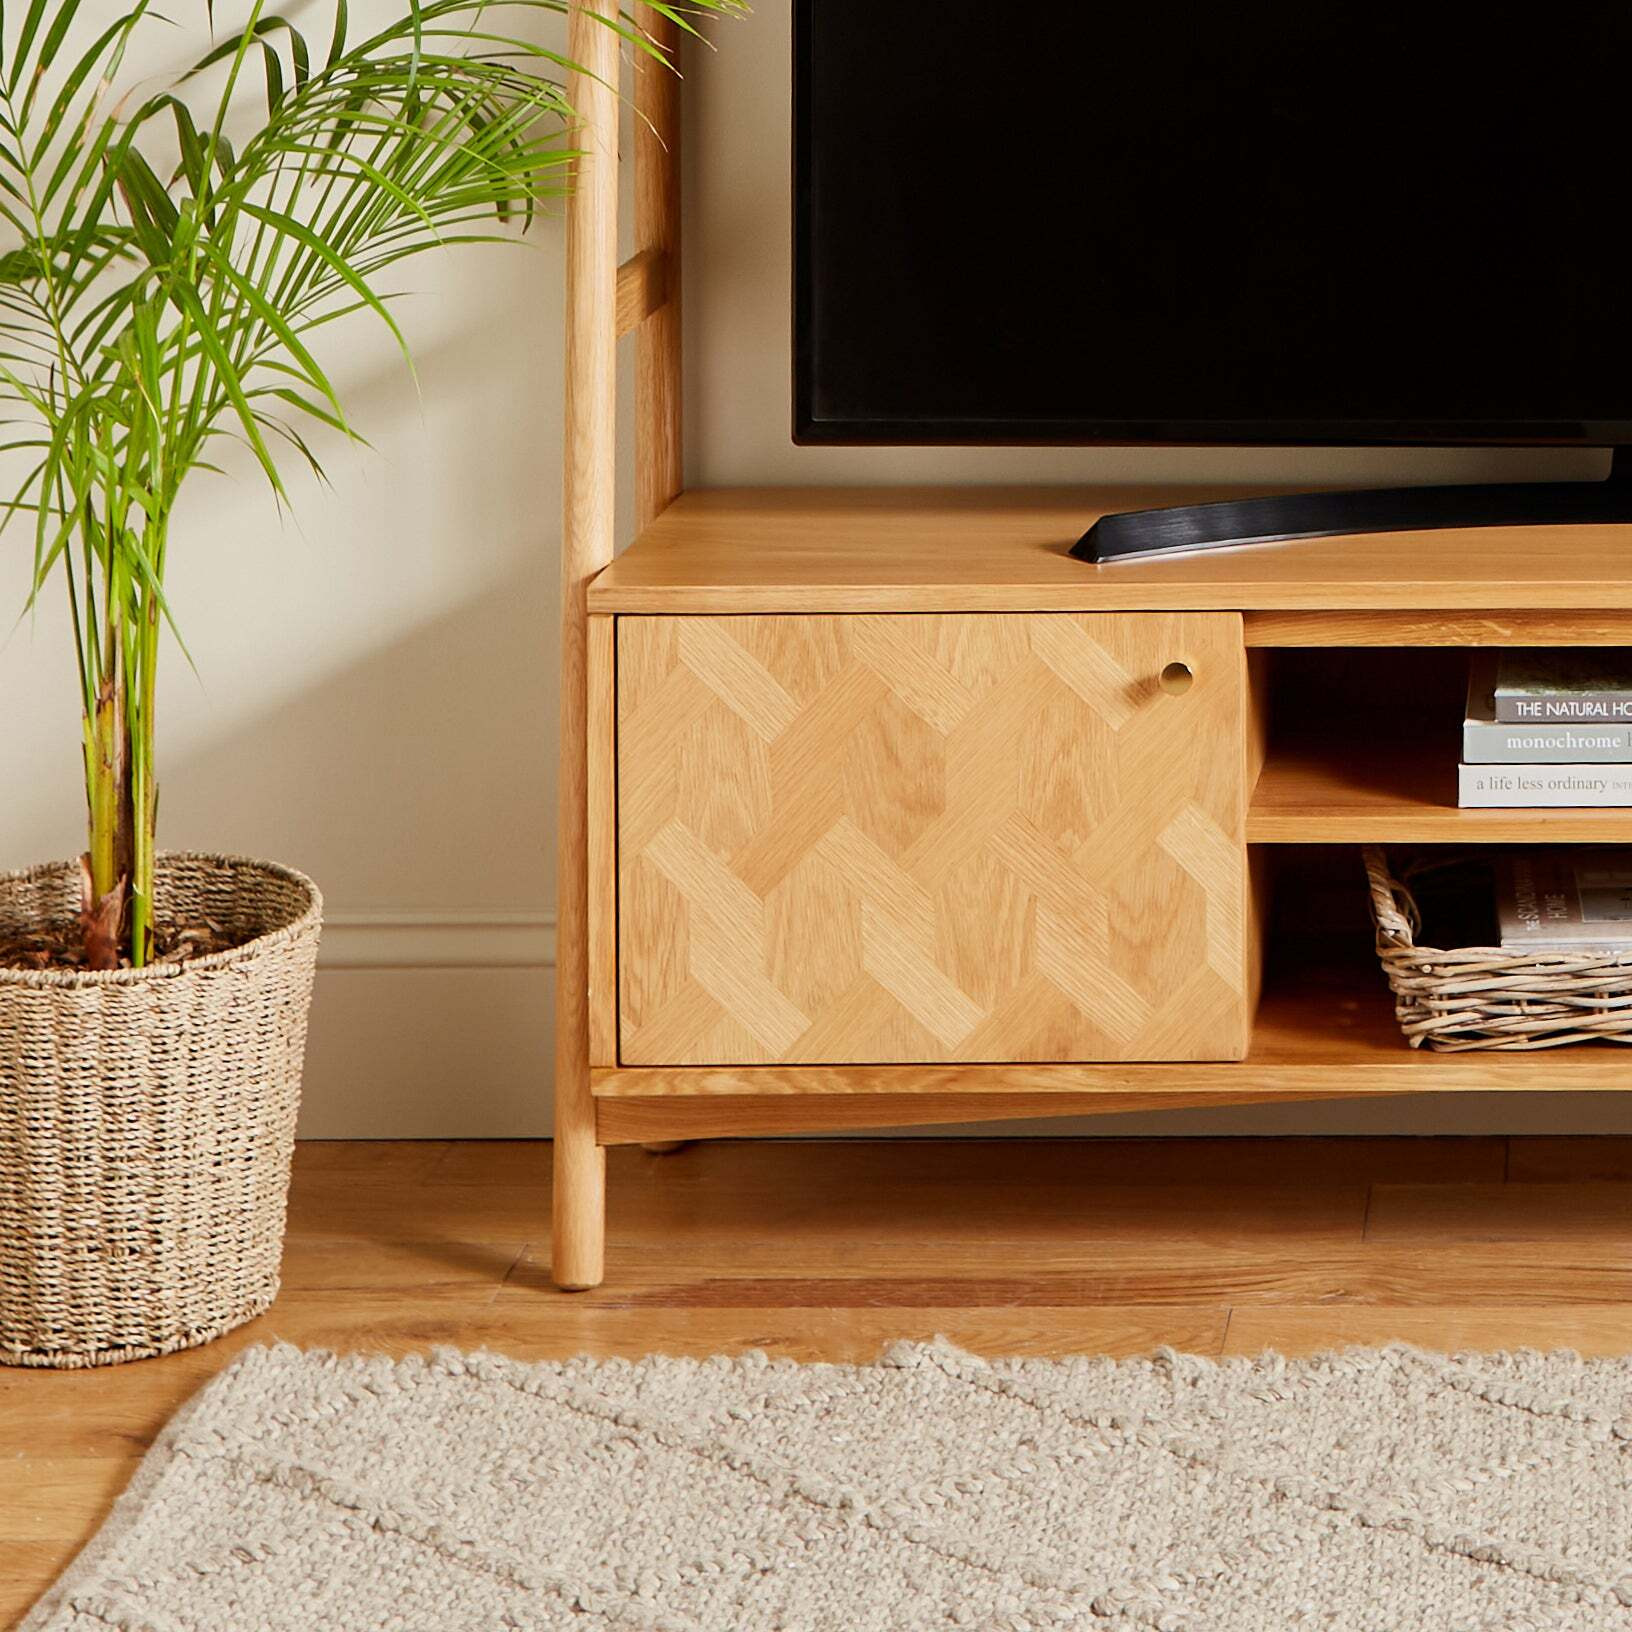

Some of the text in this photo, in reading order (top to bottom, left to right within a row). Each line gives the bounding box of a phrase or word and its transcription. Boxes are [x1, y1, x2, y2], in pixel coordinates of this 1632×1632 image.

[1515, 701, 1542, 717] THE
[1546, 701, 1609, 717] NATURAL
[1506, 731, 1622, 749] monochrome
[1476, 776, 1608, 793] a life less ordinary
